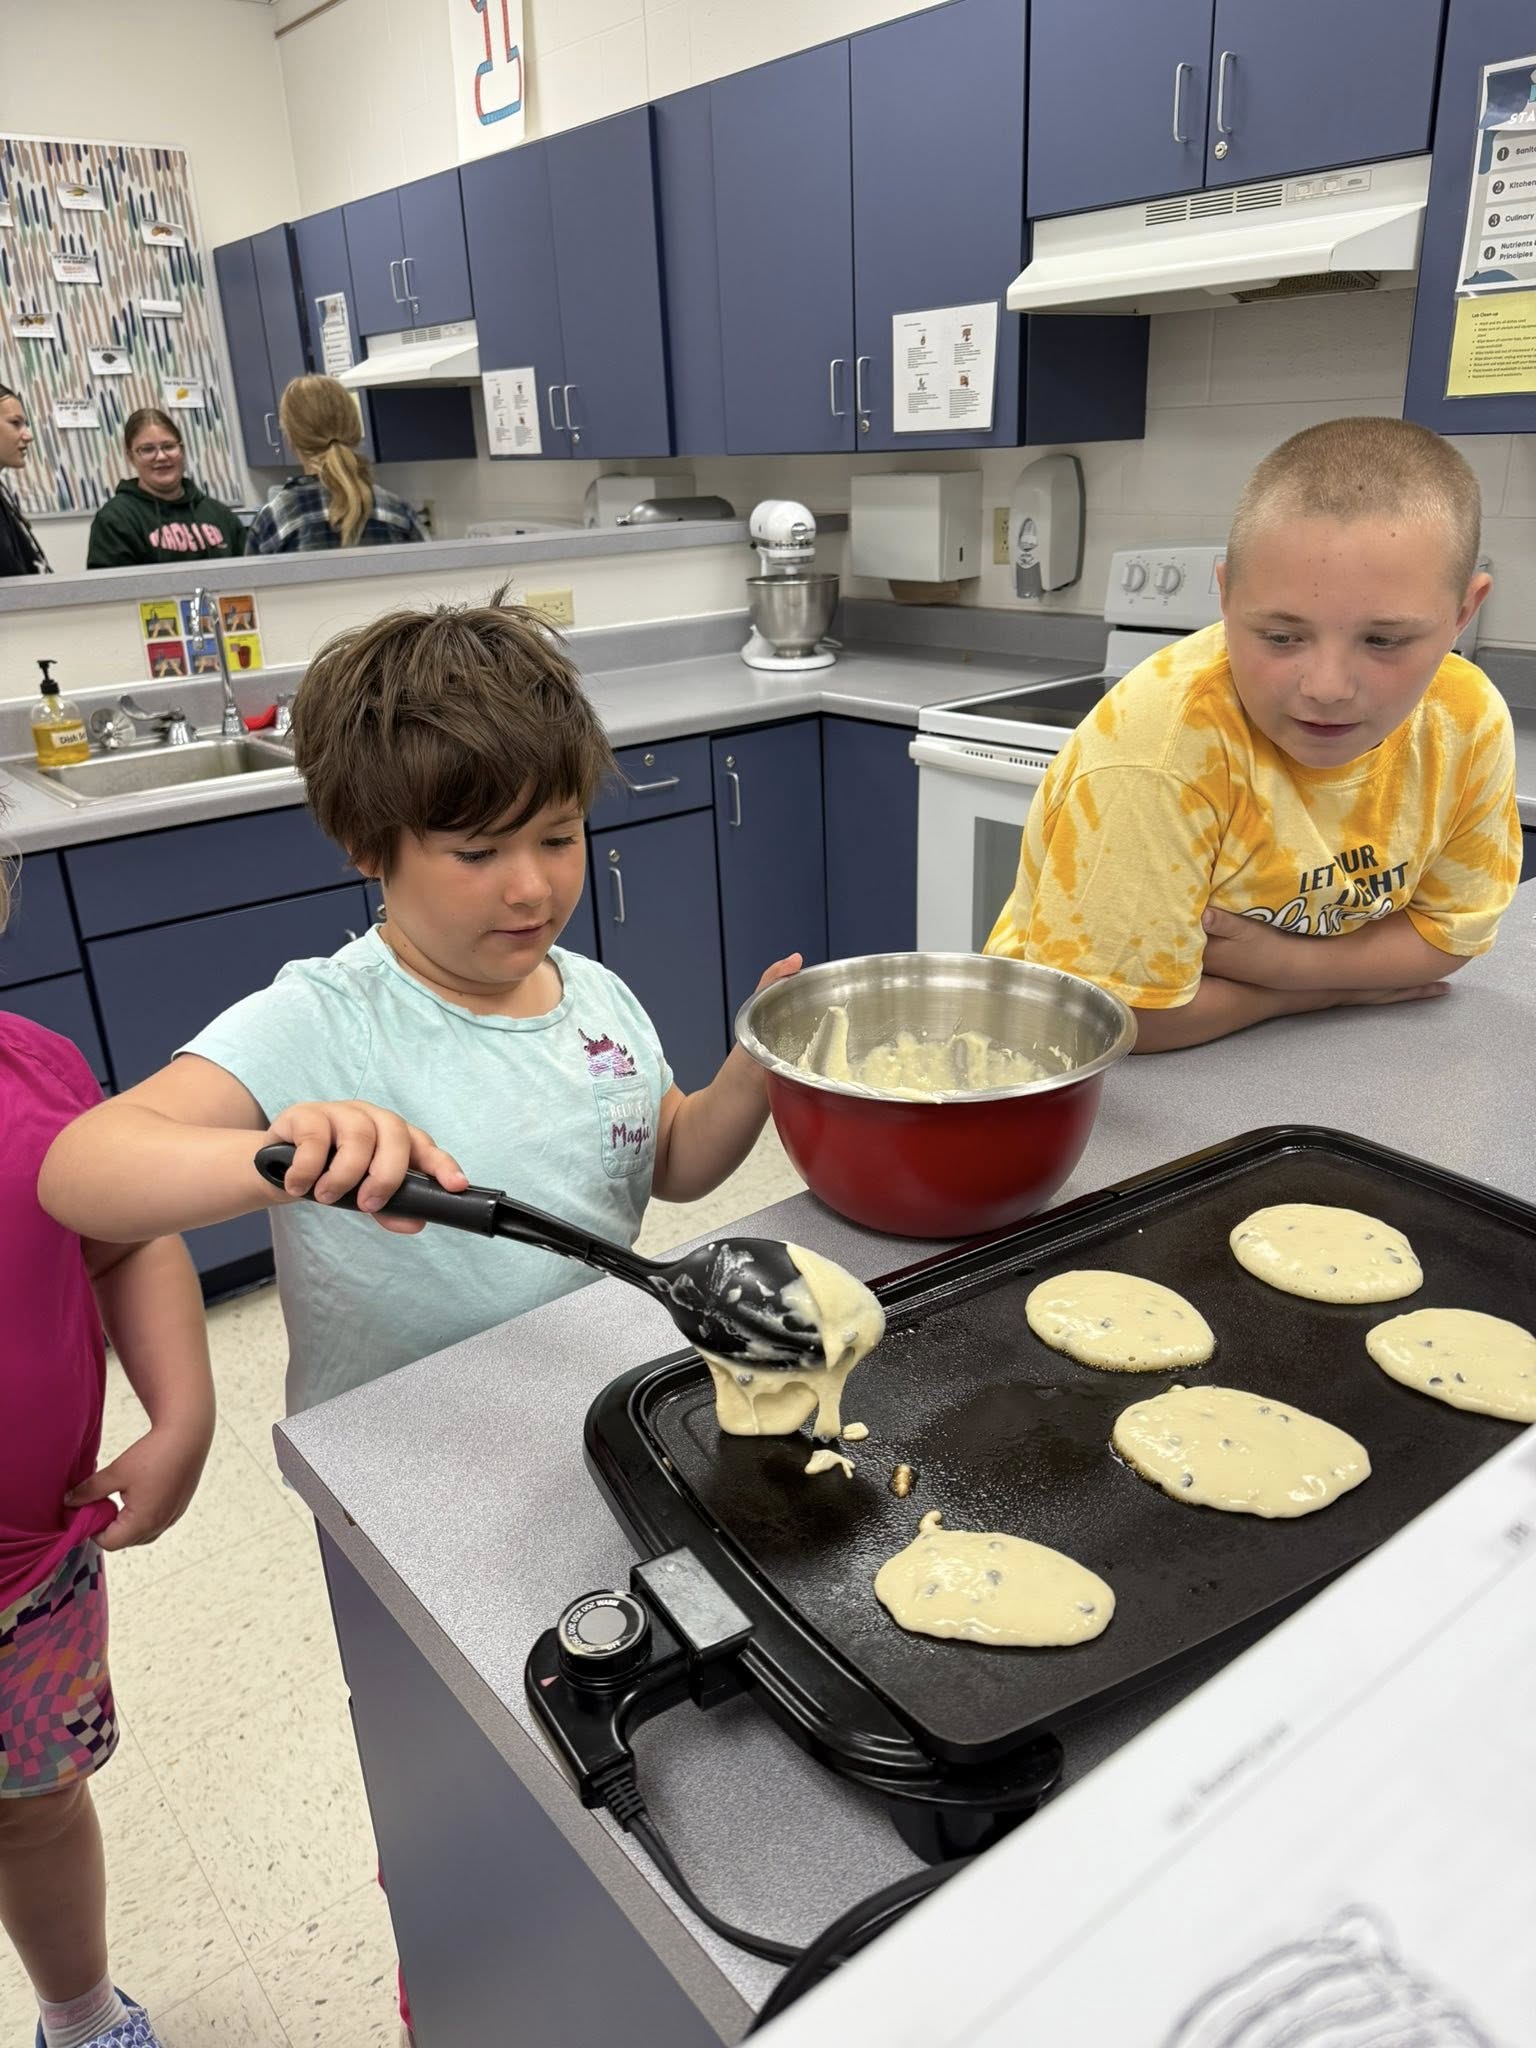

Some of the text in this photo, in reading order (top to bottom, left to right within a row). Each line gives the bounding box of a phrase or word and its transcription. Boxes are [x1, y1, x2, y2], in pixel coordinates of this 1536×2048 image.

[1505, 213, 1534, 222] Culinary
[1501, 241, 1532, 250] Nutrients
[1500, 251, 1533, 260] Principles
[1300, 844, 1379, 894] LET UR
[580, 1601, 597, 1612] 200
[570, 1610, 584, 1623] 250
[567, 1622, 577, 1635] 300
